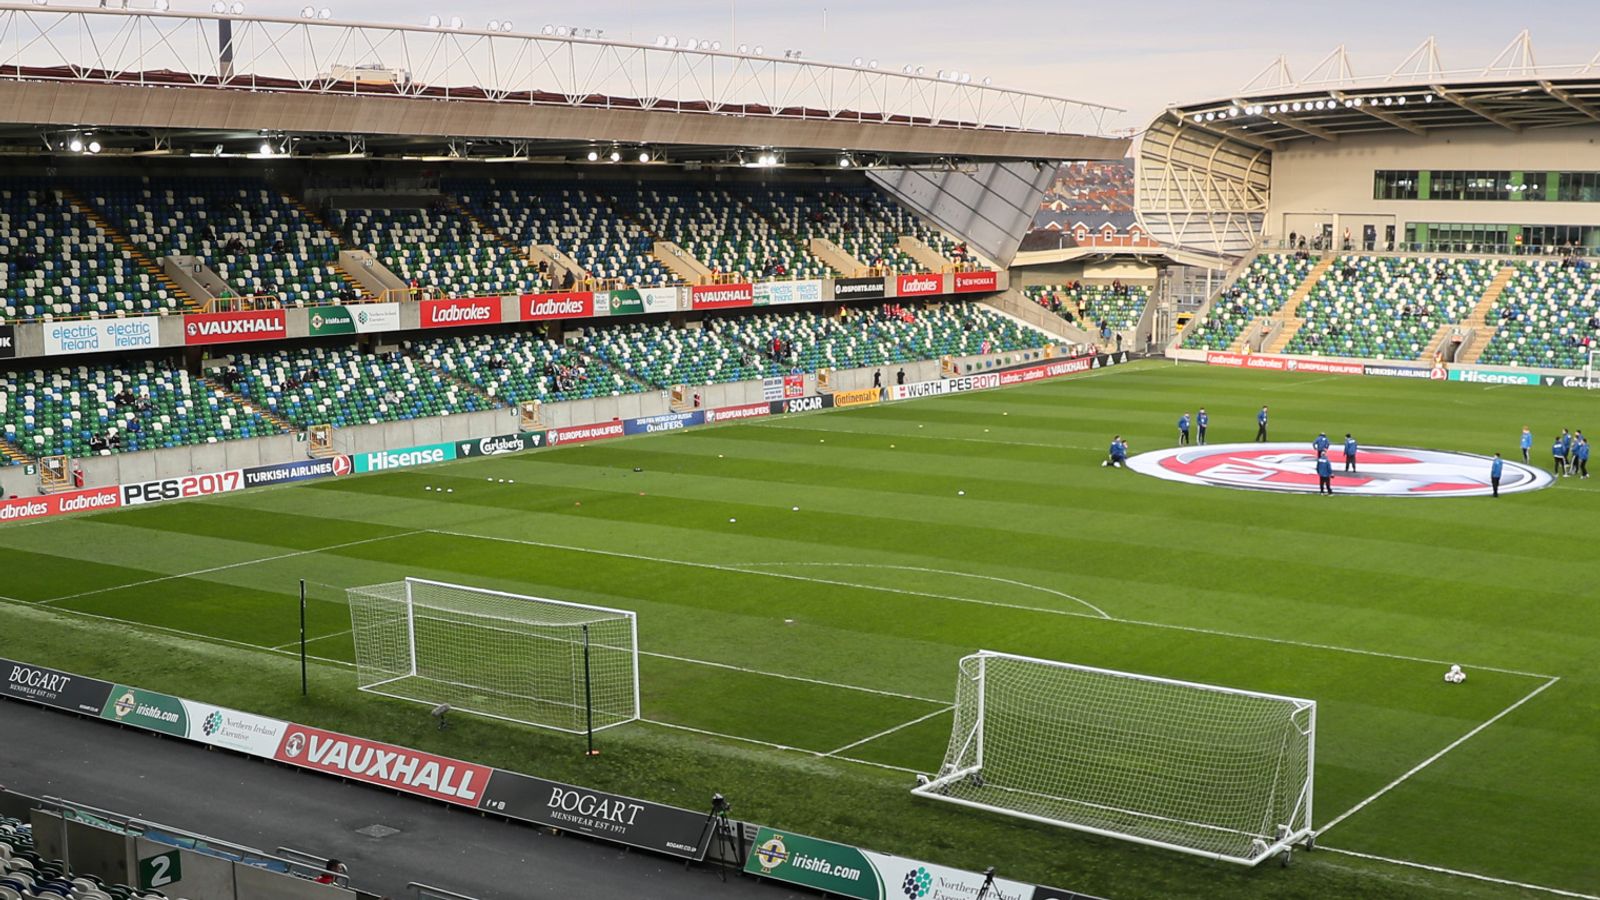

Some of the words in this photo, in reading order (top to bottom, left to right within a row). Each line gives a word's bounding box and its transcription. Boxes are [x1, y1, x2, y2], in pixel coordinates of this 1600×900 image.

[903, 279, 937, 293] Ladbrokes
[700, 290, 751, 302] VAUXHALL
[432, 305, 490, 323] Ladbrokes
[530, 298, 583, 316] Ladbrokes
[52, 325, 97, 338] electric
[107, 322, 150, 335] electric
[198, 318, 283, 336] VAUXHALL
[61, 338, 98, 350] Ireland
[115, 334, 151, 346] Ireland
[1051, 359, 1089, 375] VAUXHALL
[1247, 357, 1283, 368] Ladbrokes
[1365, 367, 1396, 376] TURKISH
[1396, 369, 1430, 378] AIRLINES
[1460, 370, 1528, 385] Hisense
[789, 397, 822, 412] SOCAR
[835, 391, 872, 407] Continental
[716, 409, 742, 420] EUROPEAN
[742, 406, 769, 417] QUALIFIERS
[299, 433, 305, 442] 7
[559, 428, 590, 441] EUROPEAN
[591, 424, 623, 437] QUALIFIERS
[479, 436, 524, 456] Carlsberg
[367, 448, 443, 471] Hisense
[27, 465, 34, 474] 5
[246, 468, 289, 484] TURKISH
[290, 463, 332, 477] AIRLINES
[59, 492, 117, 512] Ladbrokes
[8, 665, 71, 693] BOGART
[135, 703, 179, 723] irishfa.com
[220, 728, 250, 742] Executive
[225, 718, 252, 731] Northern
[253, 724, 277, 737] Ireland
[307, 735, 476, 800] VAUXHALL
[547, 787, 645, 825] BOGART
[550, 810, 594, 828] MENSWEAR
[594, 821, 611, 831] EST
[611, 824, 626, 834] 1971
[151, 856, 171, 887] 2
[792, 853, 861, 881] irishfa.com
